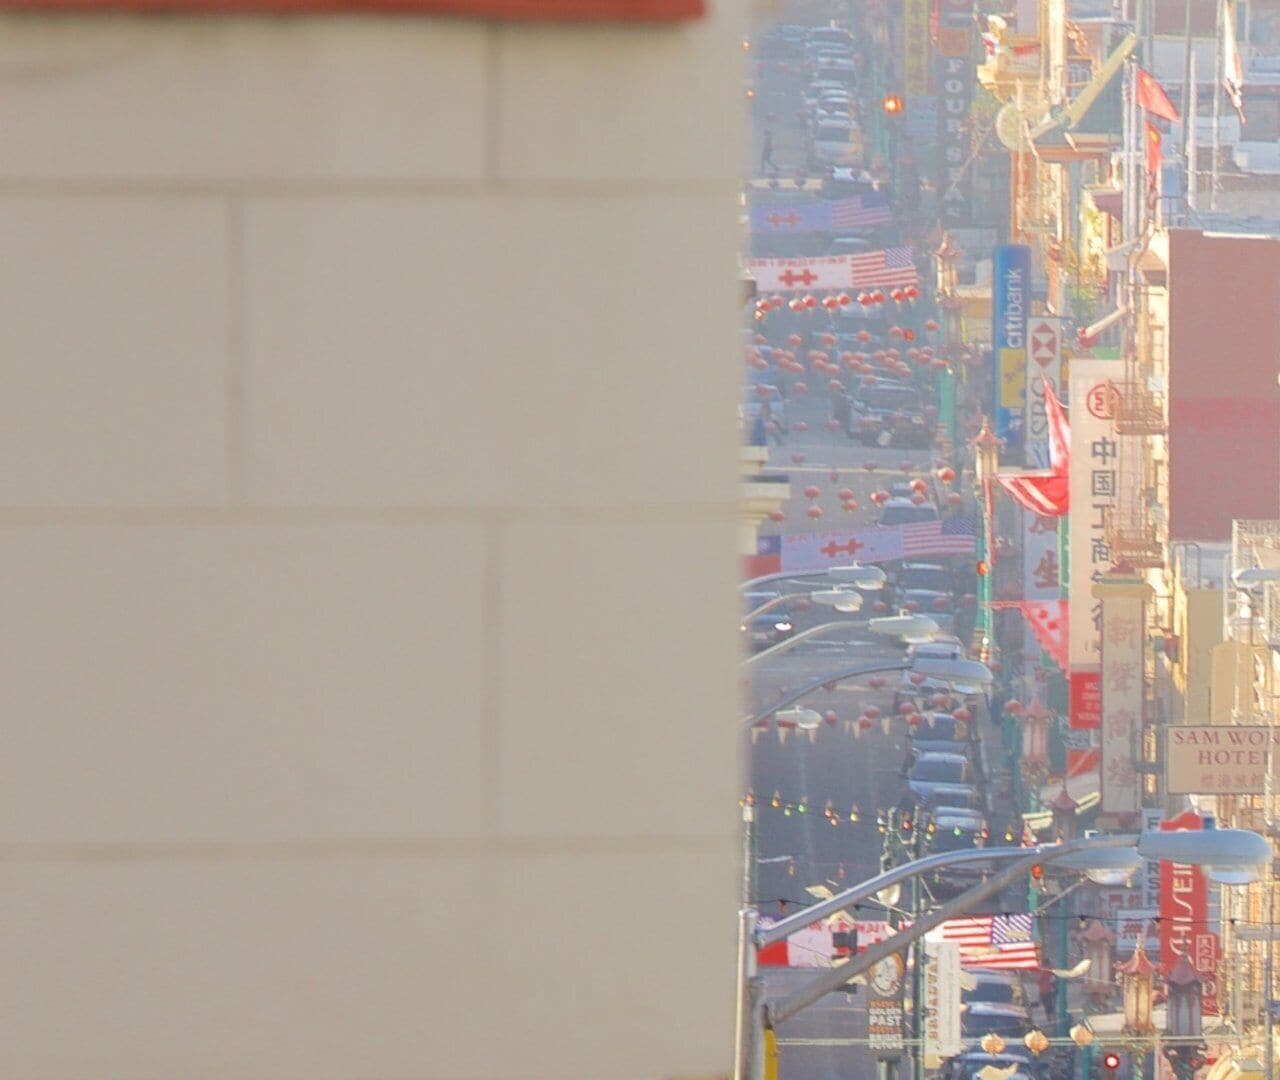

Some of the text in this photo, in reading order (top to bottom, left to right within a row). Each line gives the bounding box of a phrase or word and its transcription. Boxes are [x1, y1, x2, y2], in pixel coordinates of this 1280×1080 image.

[1007, 268, 1022, 348] citibank
[1173, 730, 1220, 745] SAM
[869, 1015, 902, 1026] PAST
